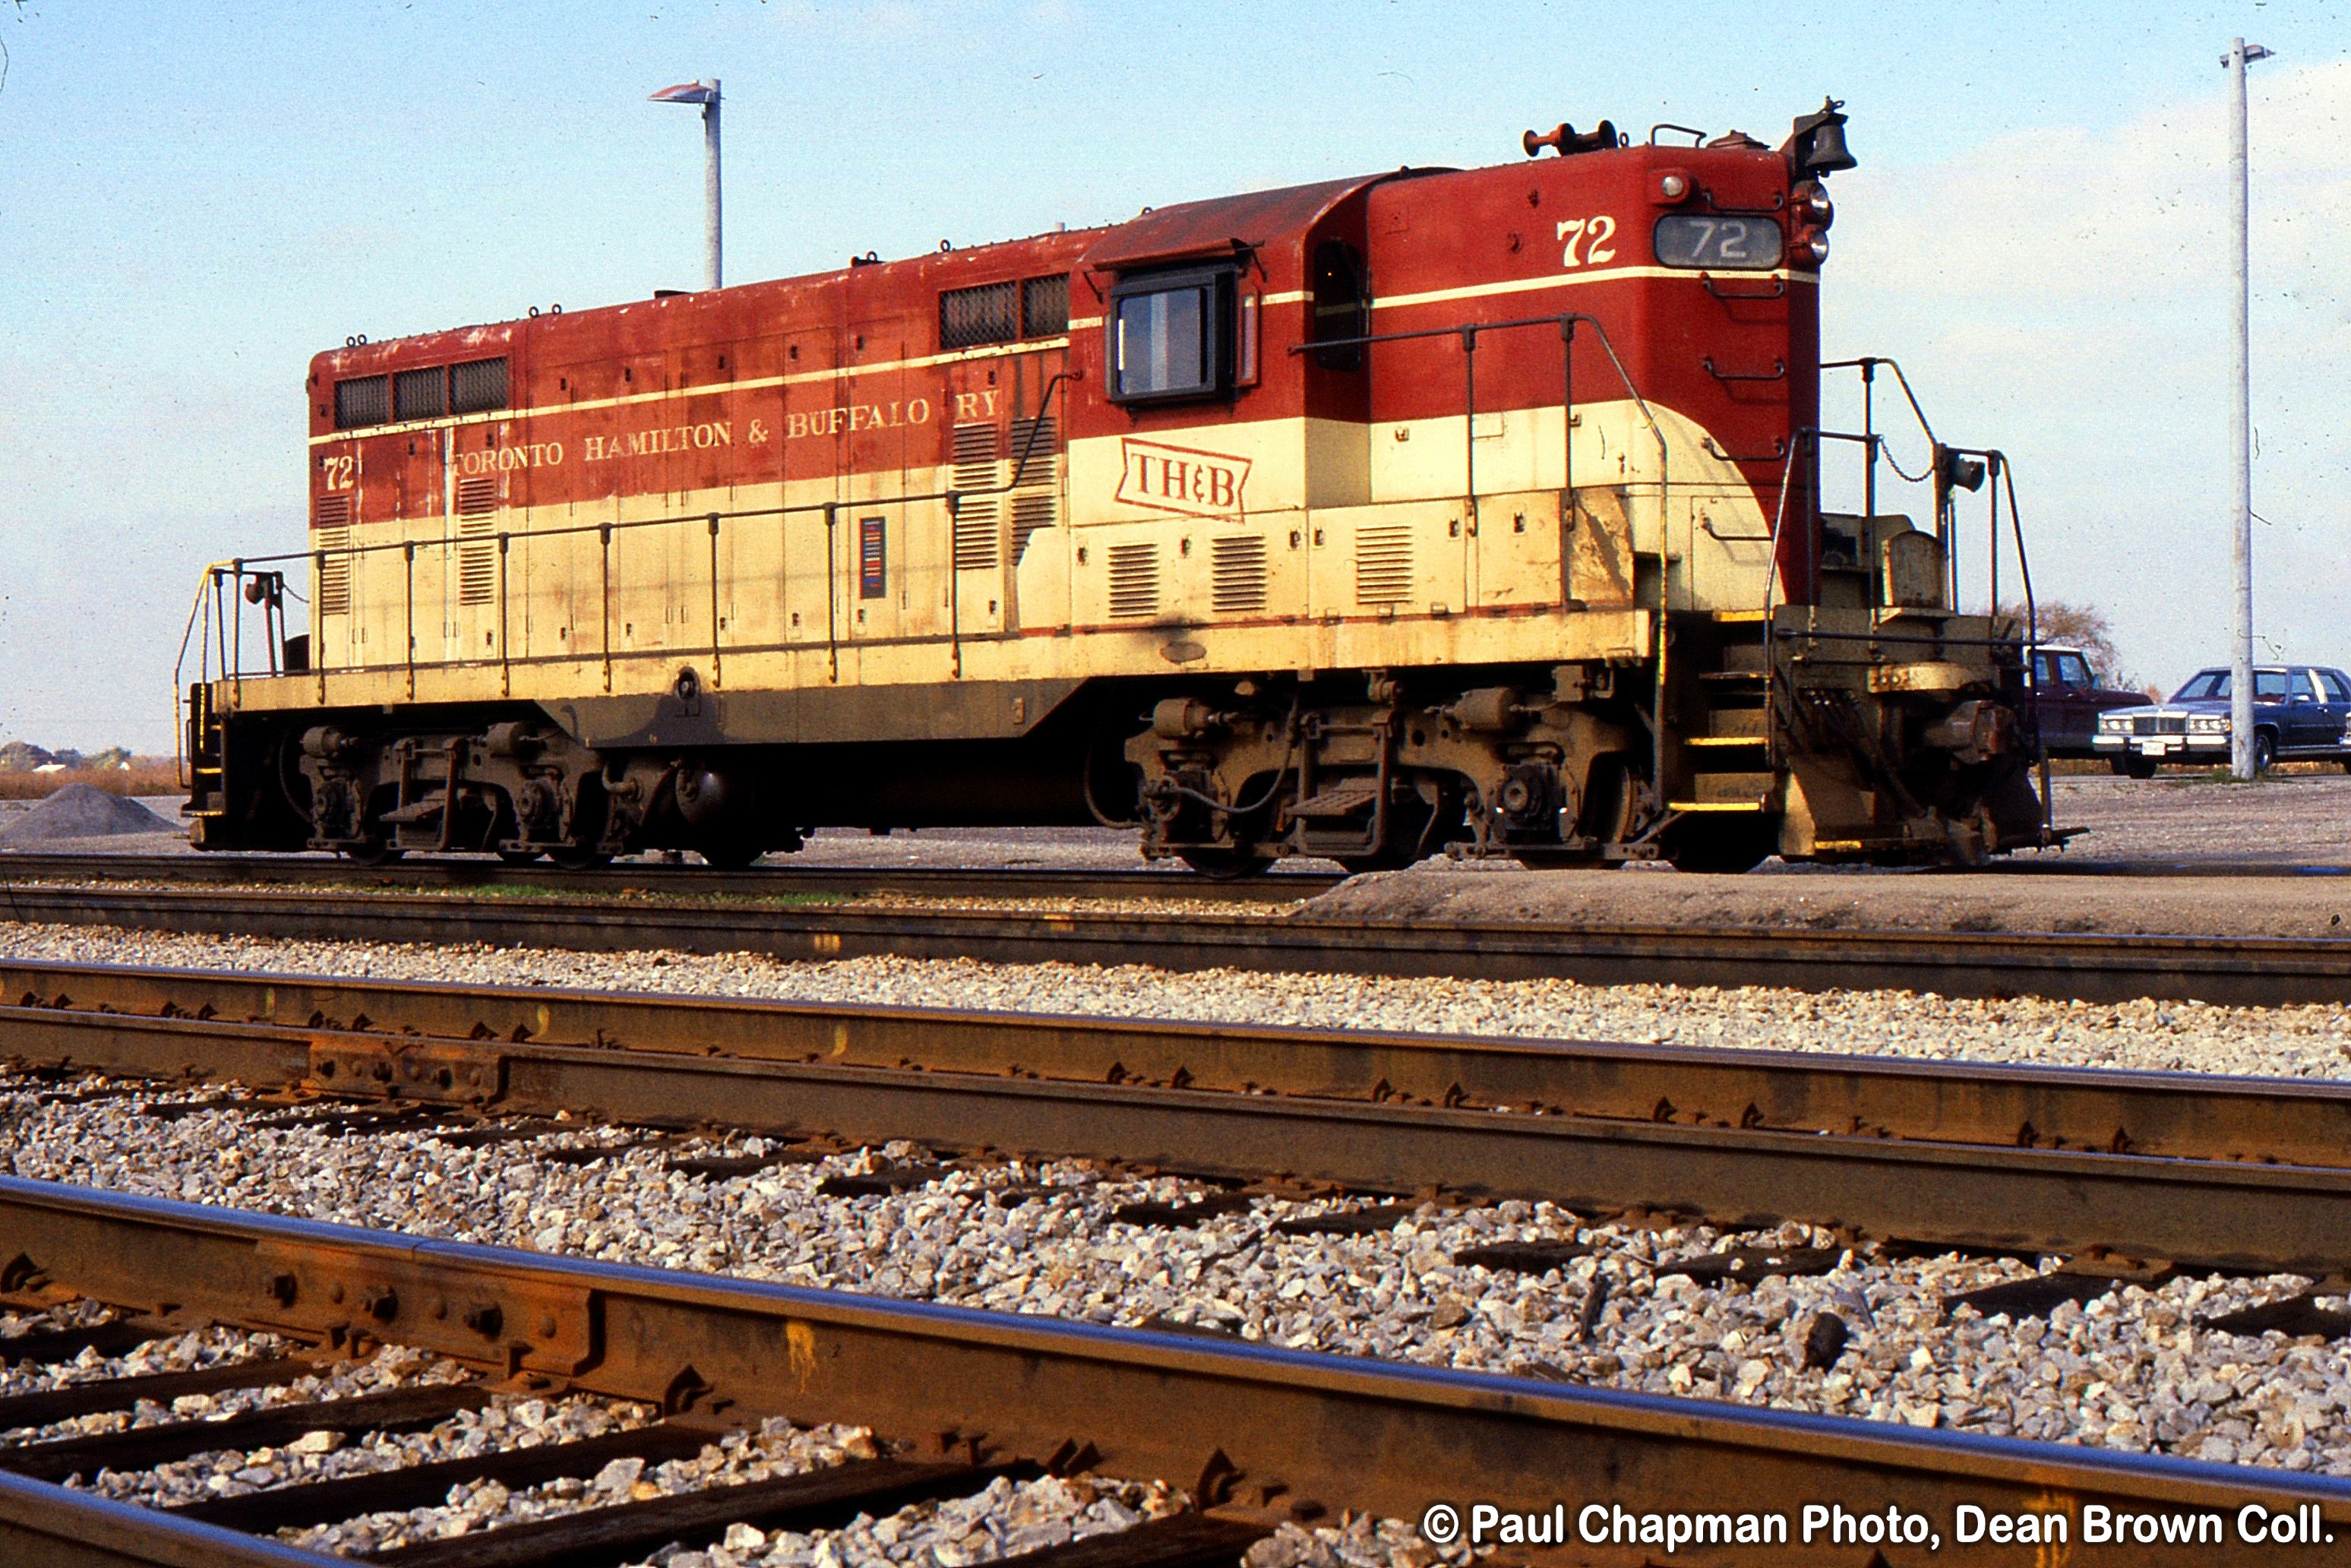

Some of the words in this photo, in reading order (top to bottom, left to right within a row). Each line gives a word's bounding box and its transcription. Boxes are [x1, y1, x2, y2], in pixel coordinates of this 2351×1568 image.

[1556, 216, 1616, 267] 72
[1689, 220, 1746, 258] 72
[452, 442, 564, 477] TORONTO
[584, 421, 732, 462] HAMILTON
[748, 419, 769, 443] &
[788, 397, 931, 439] BUFFALO
[956, 390, 1003, 420] RY
[324, 456, 355, 492] 72
[1131, 453, 1235, 507] TH&B
